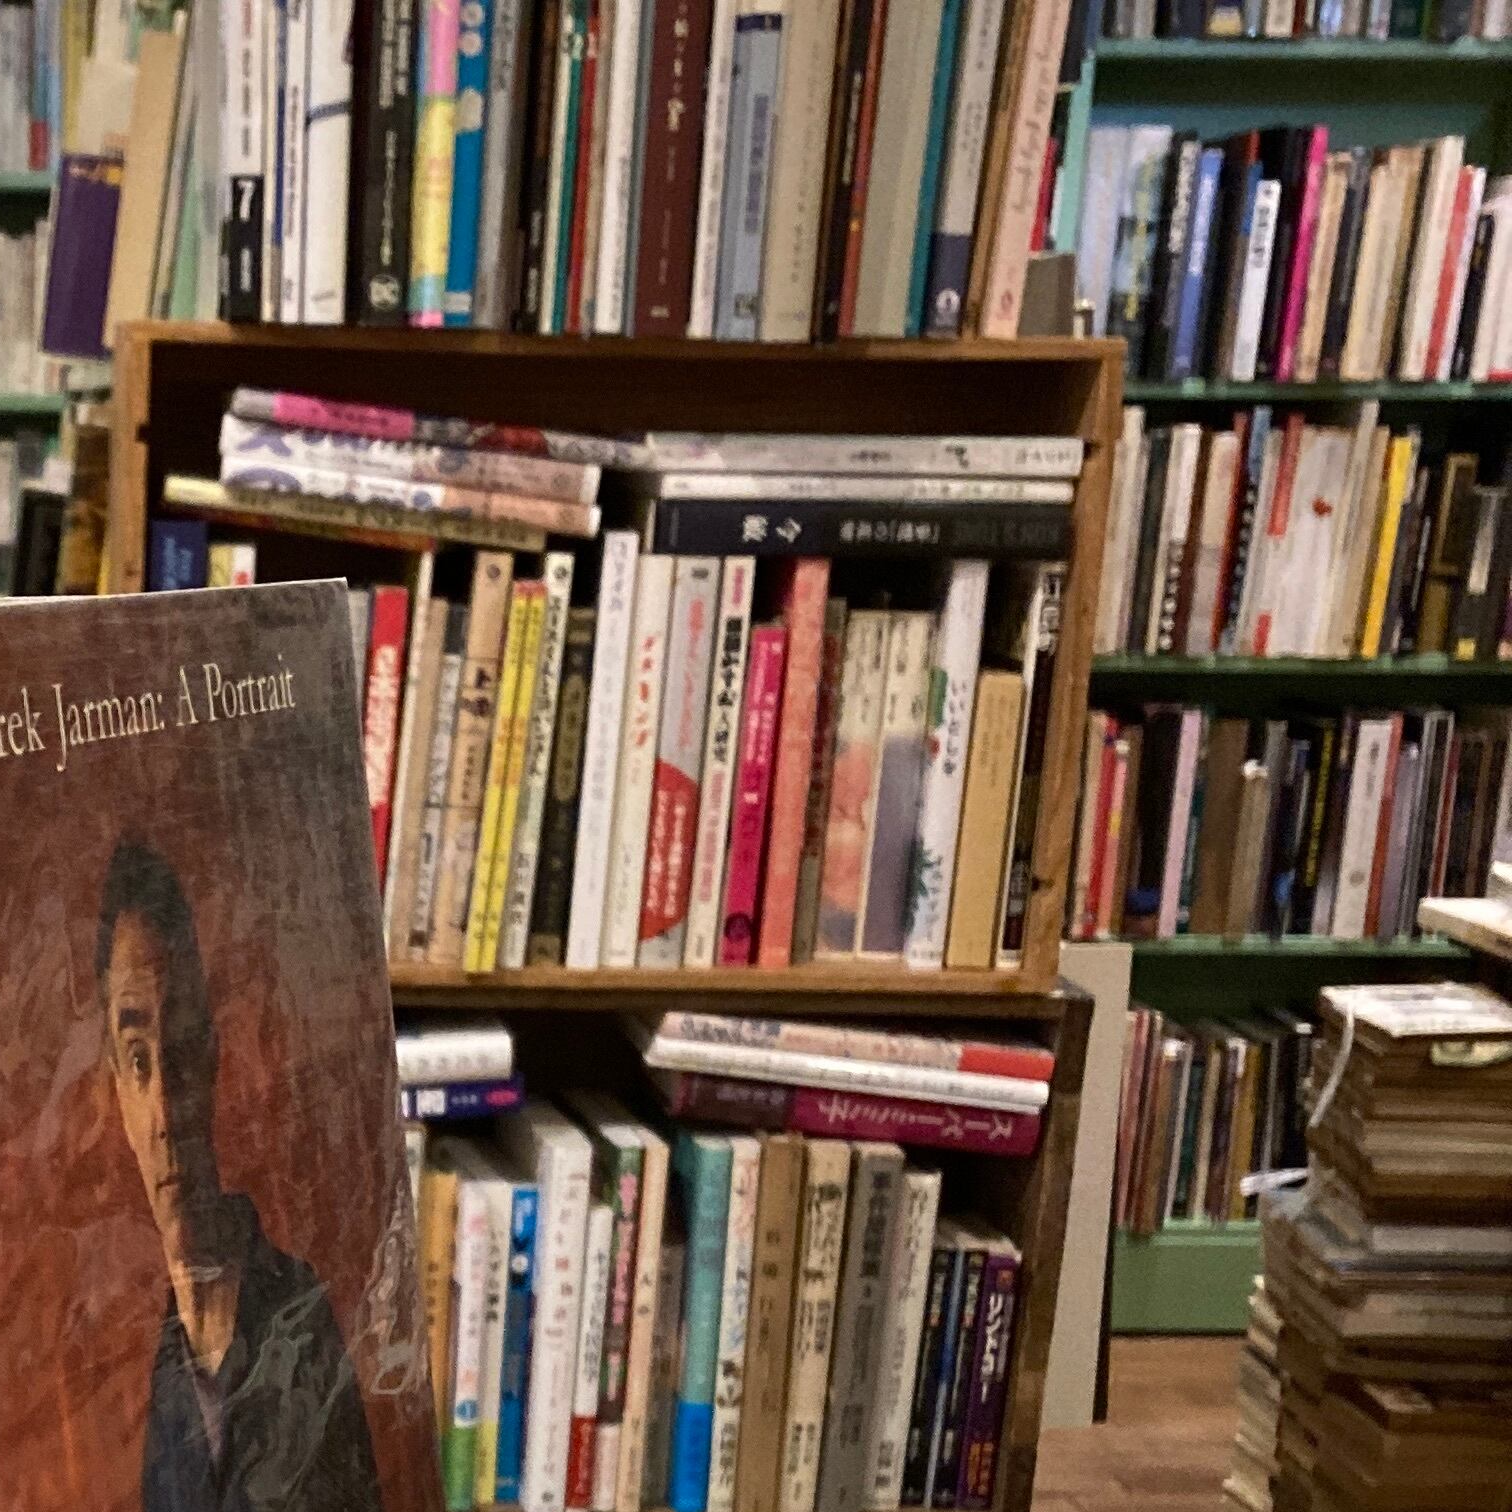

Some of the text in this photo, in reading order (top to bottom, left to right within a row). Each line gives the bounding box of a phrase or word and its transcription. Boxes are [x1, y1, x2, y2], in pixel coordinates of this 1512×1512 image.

[53, 683, 165, 771] Jarman:
[175, 667, 199, 727] A
[203, 654, 297, 721] Portrait
